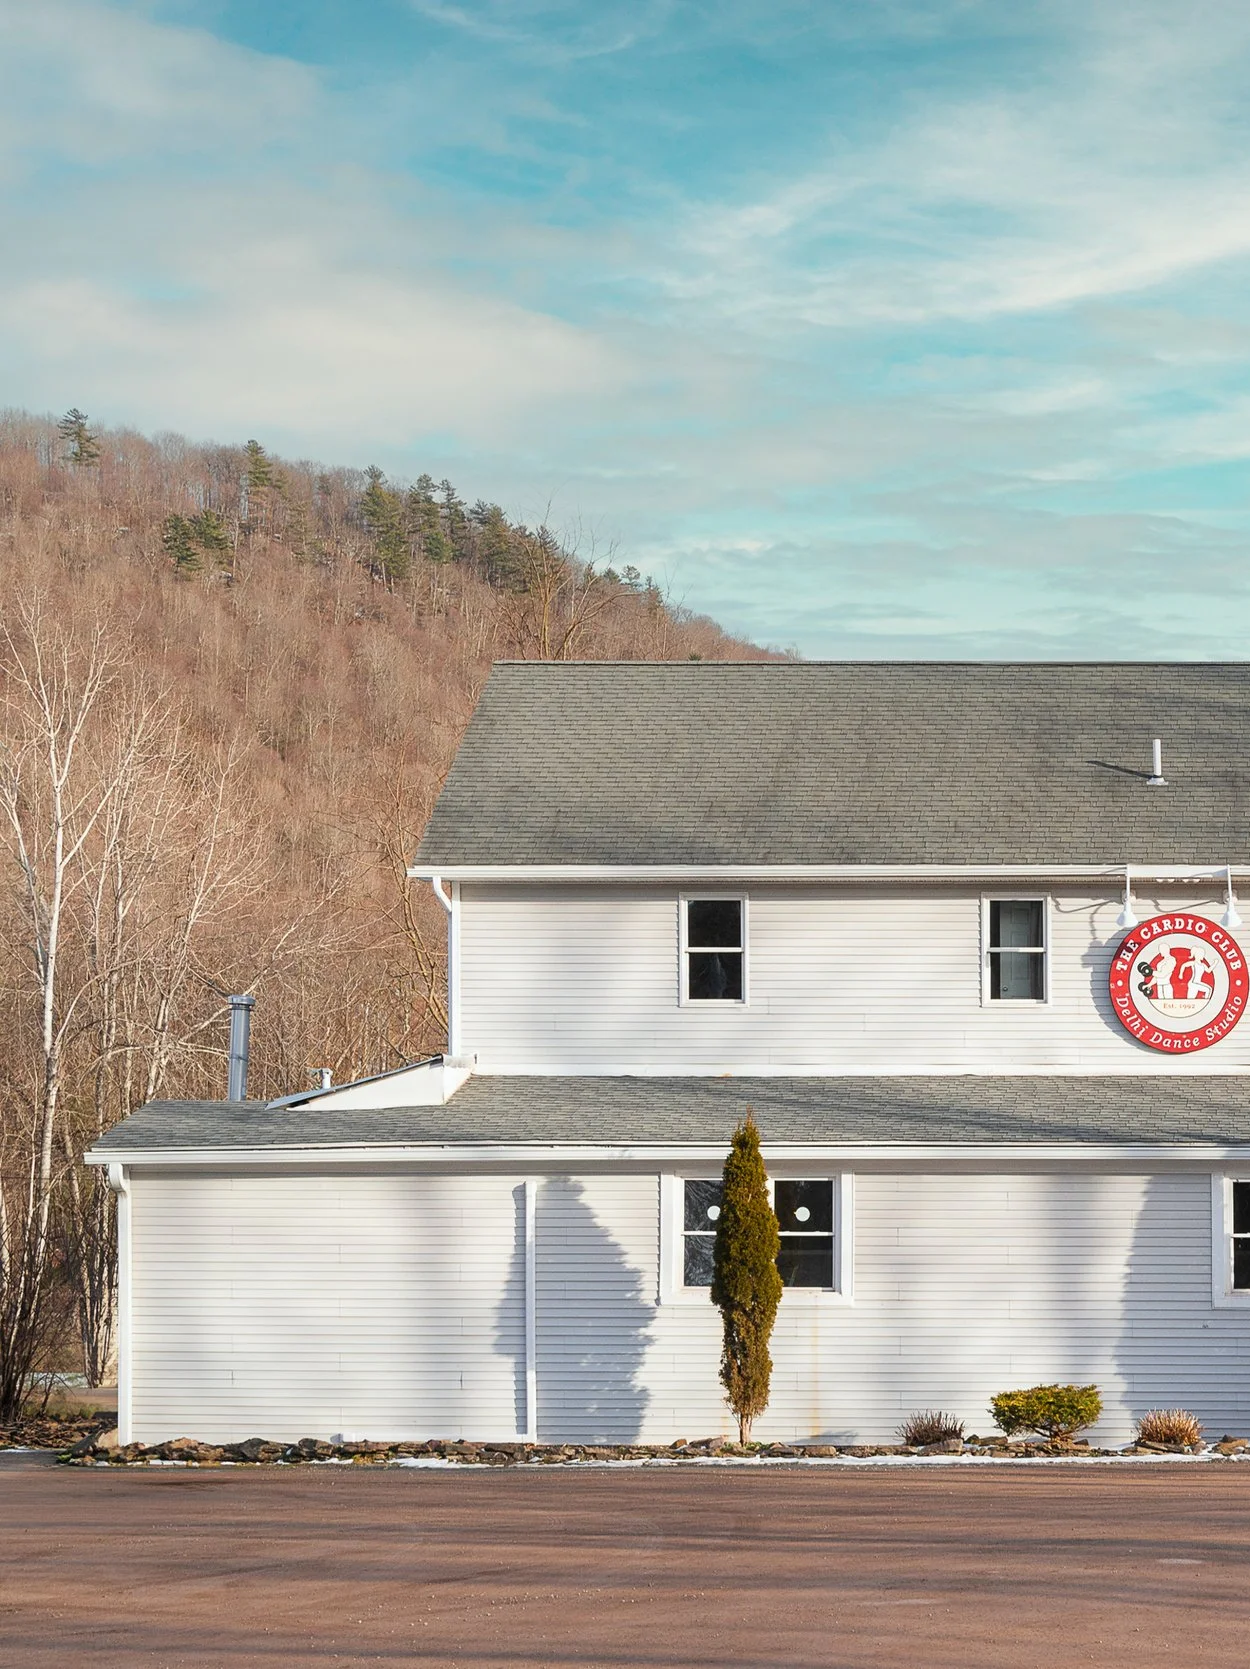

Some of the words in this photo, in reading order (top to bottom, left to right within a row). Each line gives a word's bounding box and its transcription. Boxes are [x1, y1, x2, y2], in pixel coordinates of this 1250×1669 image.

[1115, 940, 1139, 972] THE
[1140, 917, 1207, 940] CARDIO
[1211, 931, 1242, 971] CLUB
[1116, 993, 1149, 1039] Delhi
[1149, 1031, 1201, 1049] Dance
[1205, 996, 1242, 1041] Studio
